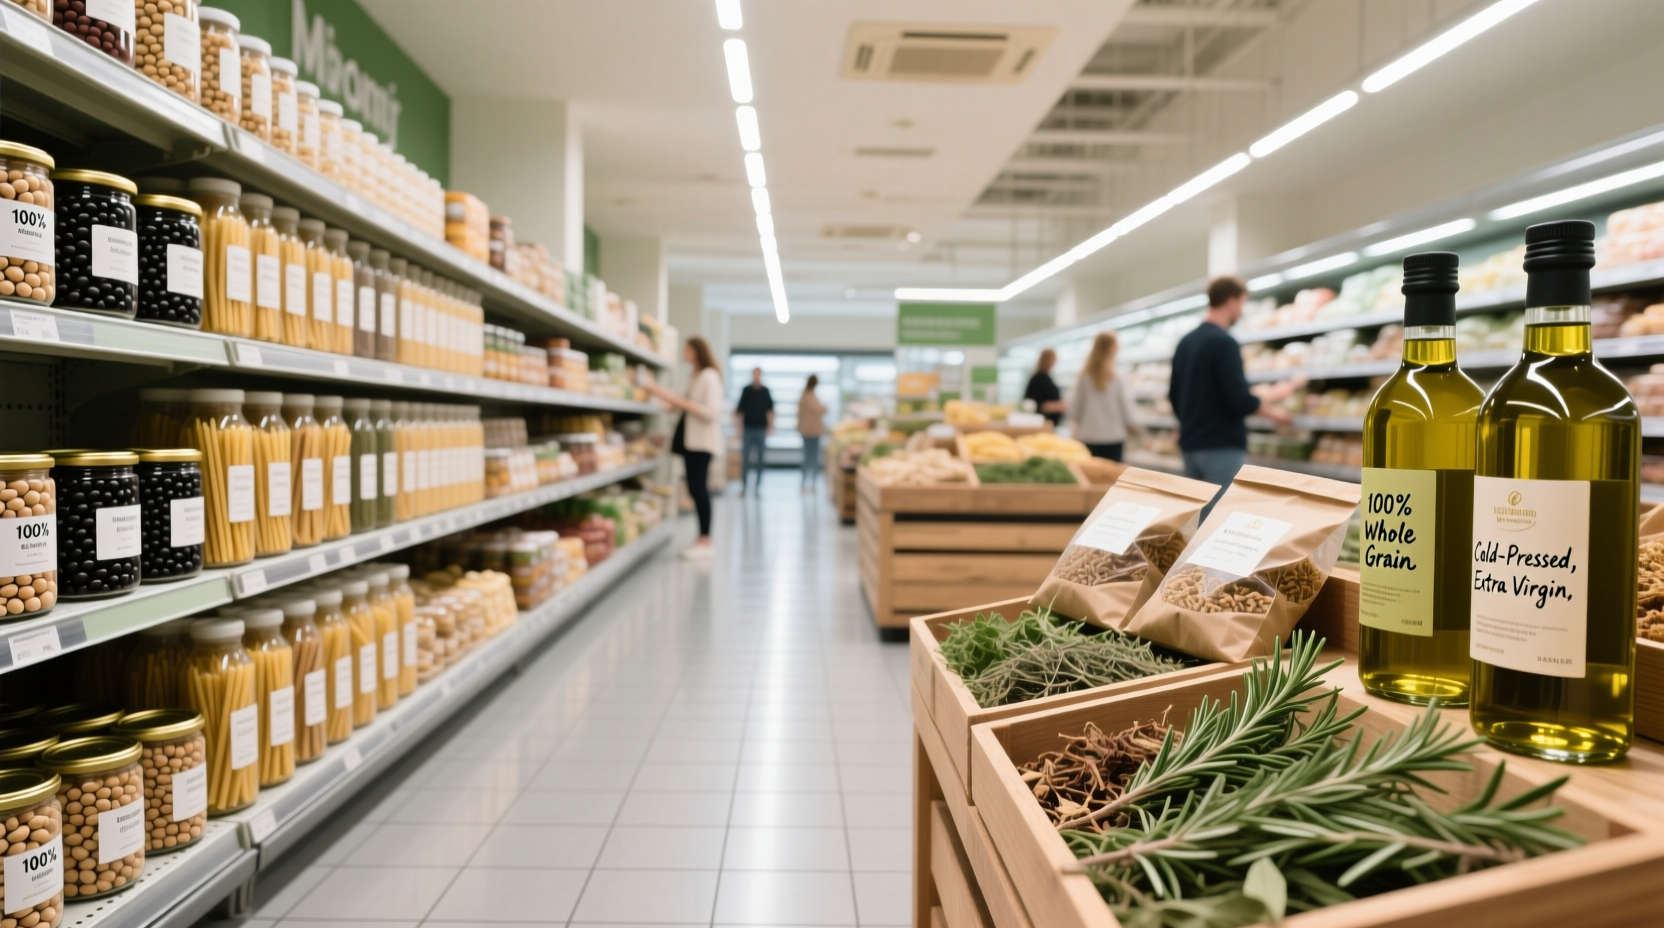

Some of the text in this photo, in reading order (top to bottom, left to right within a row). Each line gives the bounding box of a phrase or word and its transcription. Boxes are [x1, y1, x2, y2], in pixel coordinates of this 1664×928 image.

[12, 209, 47, 229] 100%
[1368, 492, 1412, 517] 100%
[16, 522, 49, 540] 100%
[1365, 519, 1416, 544] Whole
[1365, 544, 1417, 570] Grain
[1474, 541, 1576, 574] Cold-Pressed,
[1513, 575, 1572, 609] Virgin,
[22, 847, 57, 873] 100%
